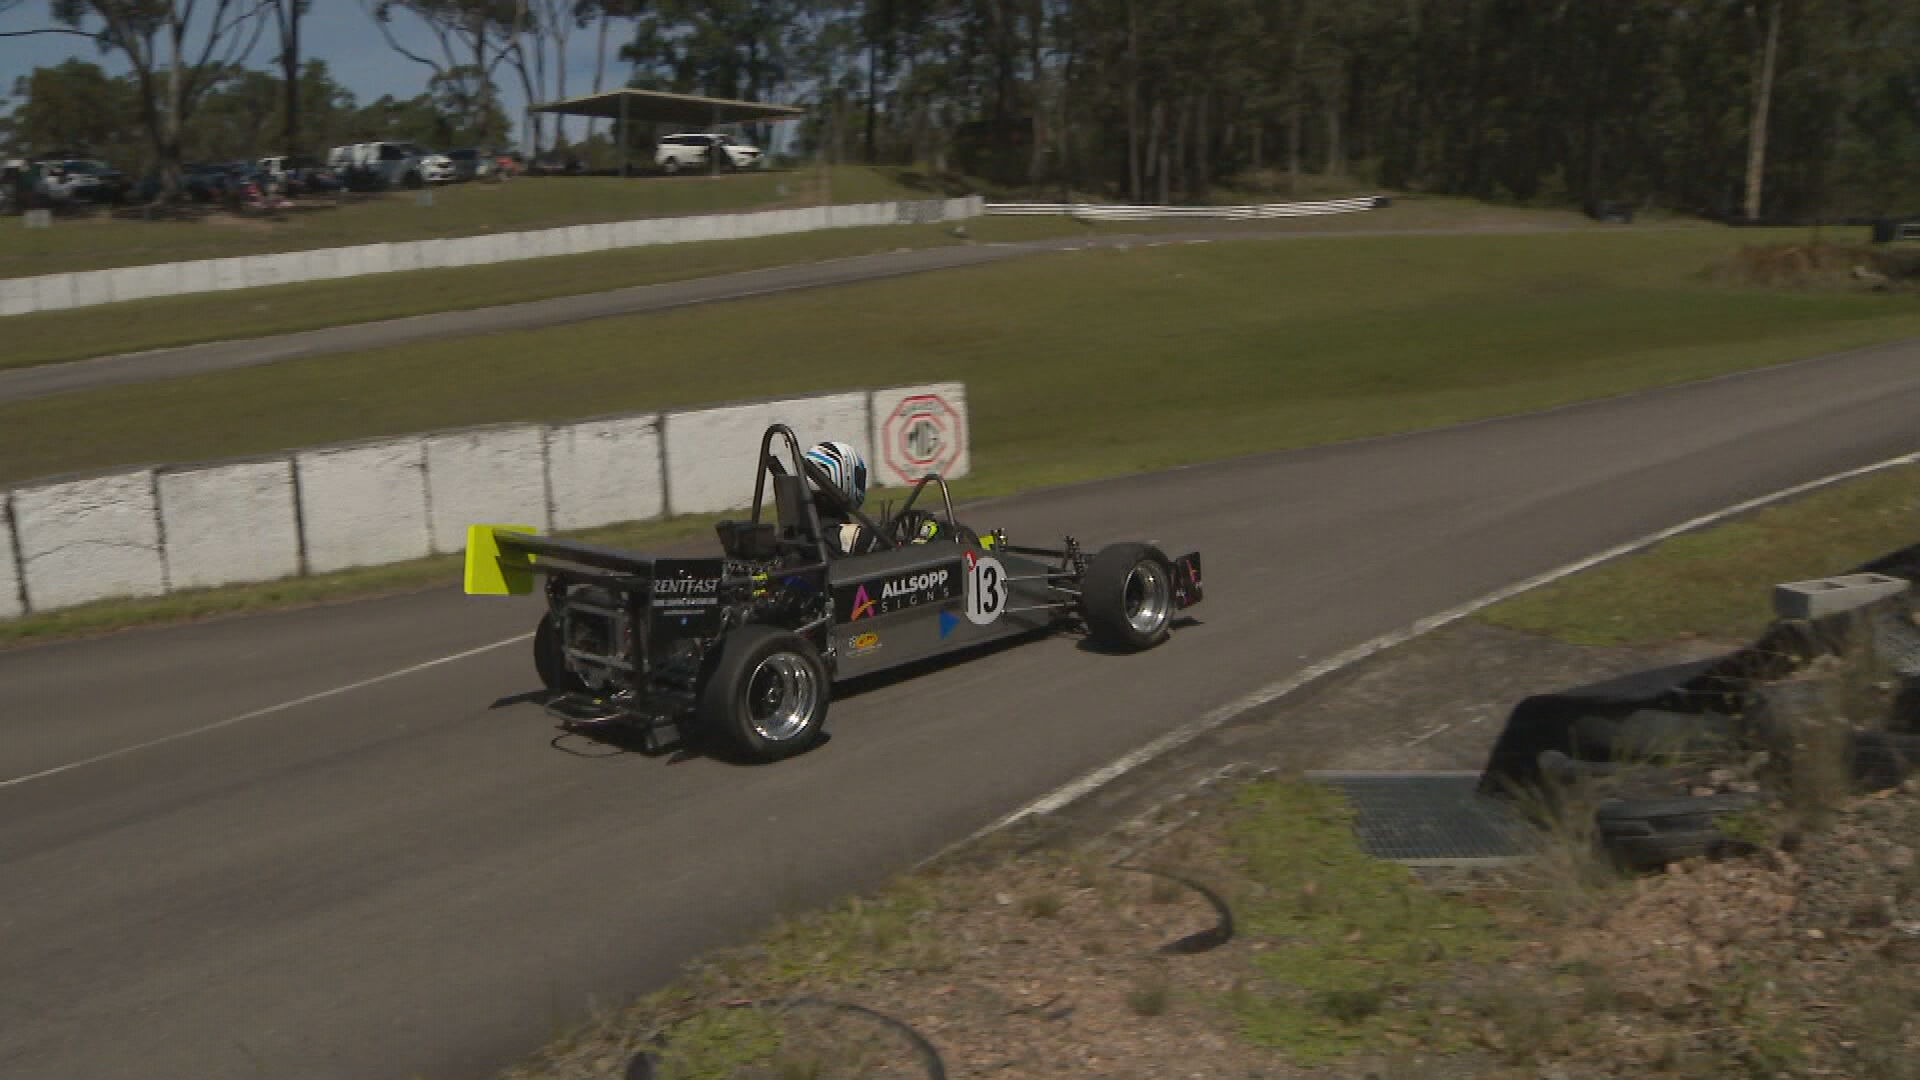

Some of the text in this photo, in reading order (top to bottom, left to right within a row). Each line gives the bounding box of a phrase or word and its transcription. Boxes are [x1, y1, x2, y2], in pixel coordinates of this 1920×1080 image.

[881, 569, 949, 599] ALLSOPP
[975, 565, 999, 615] 13
[881, 587, 950, 613] SIGNS
